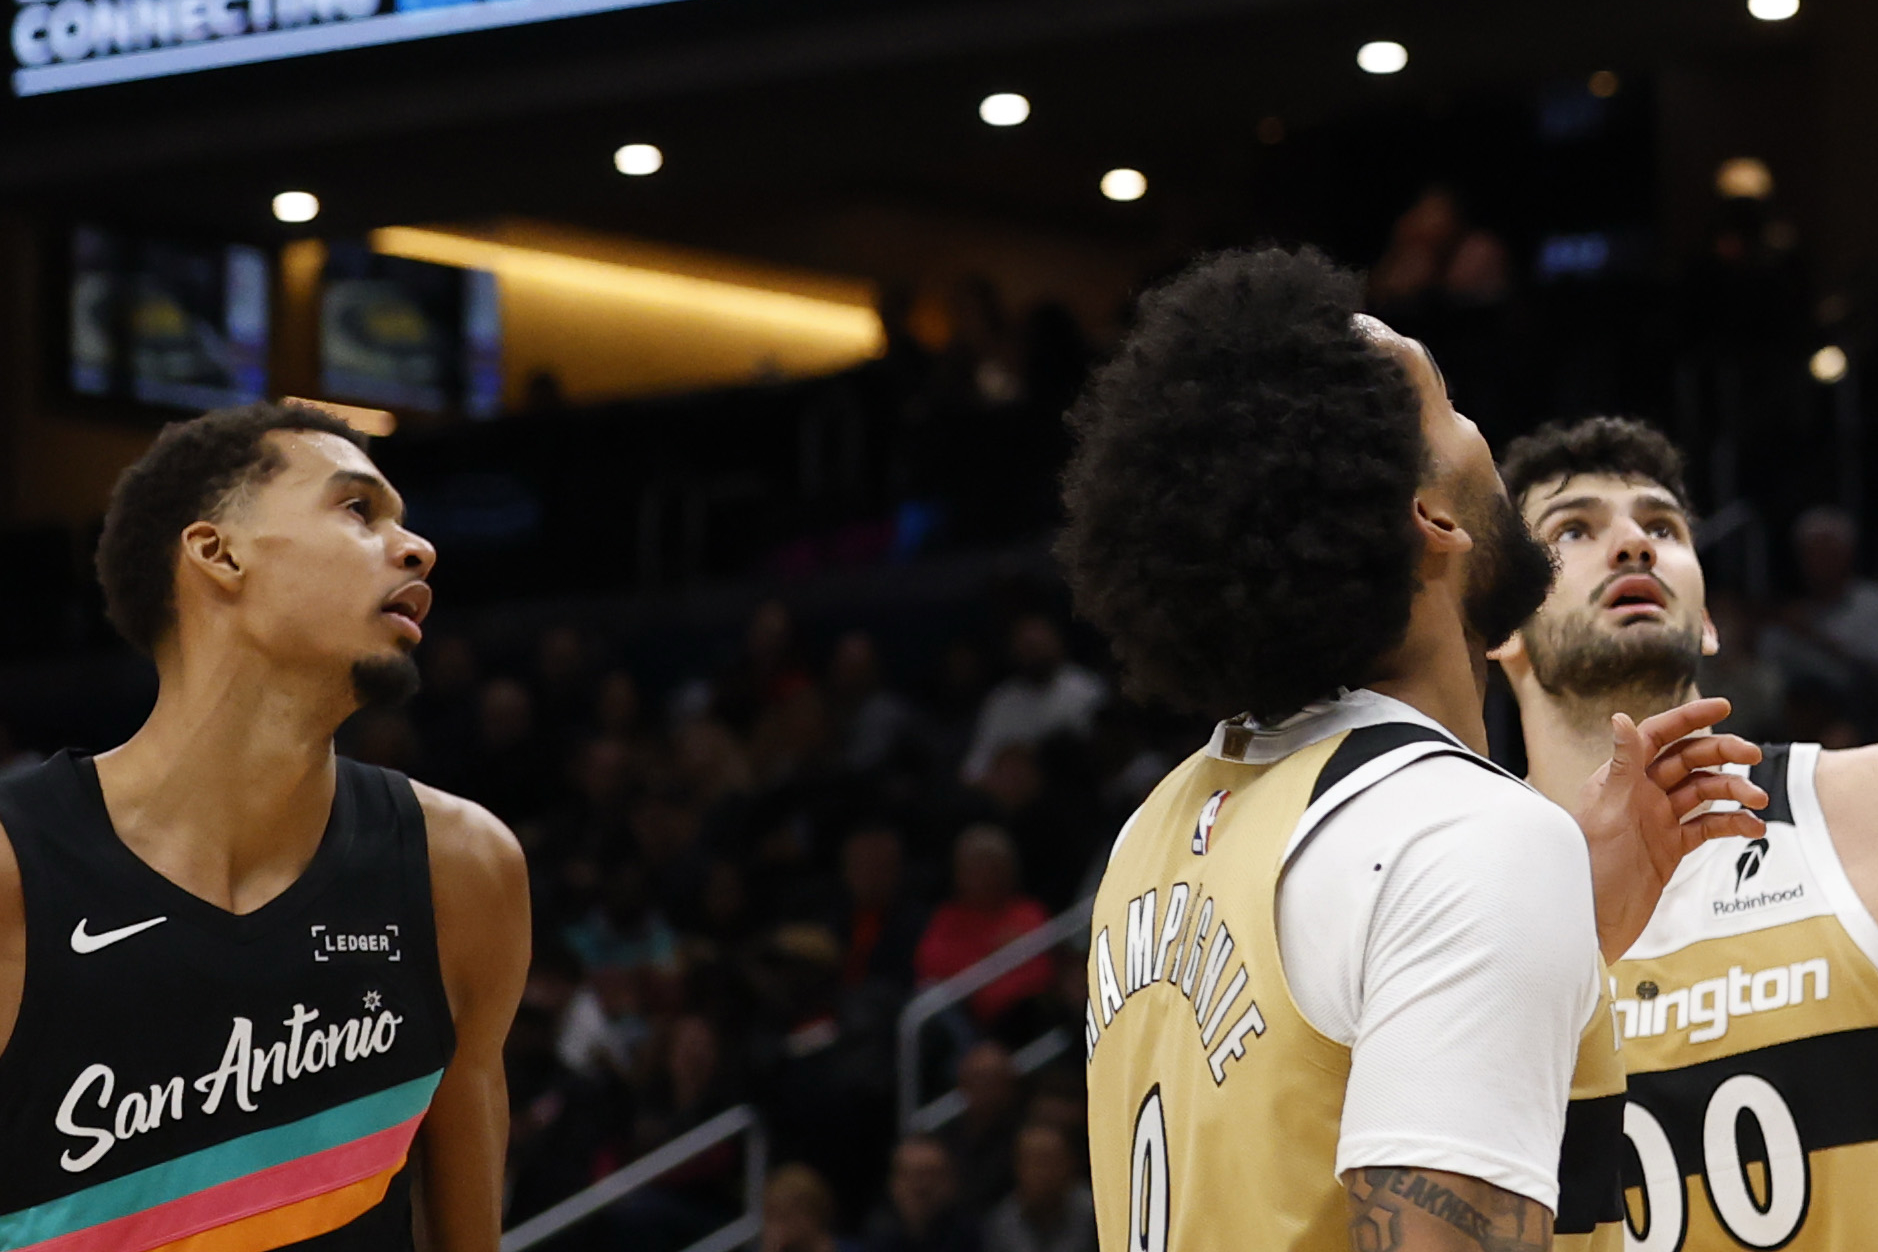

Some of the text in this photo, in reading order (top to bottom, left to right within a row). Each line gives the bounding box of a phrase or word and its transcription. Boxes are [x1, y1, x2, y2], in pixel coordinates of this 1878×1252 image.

[1712, 883, 1805, 917] Robinhood
[324, 933, 390, 953] LEDGER
[1608, 957, 1830, 1045] hington
[55, 989, 403, 1173] San Antonio
